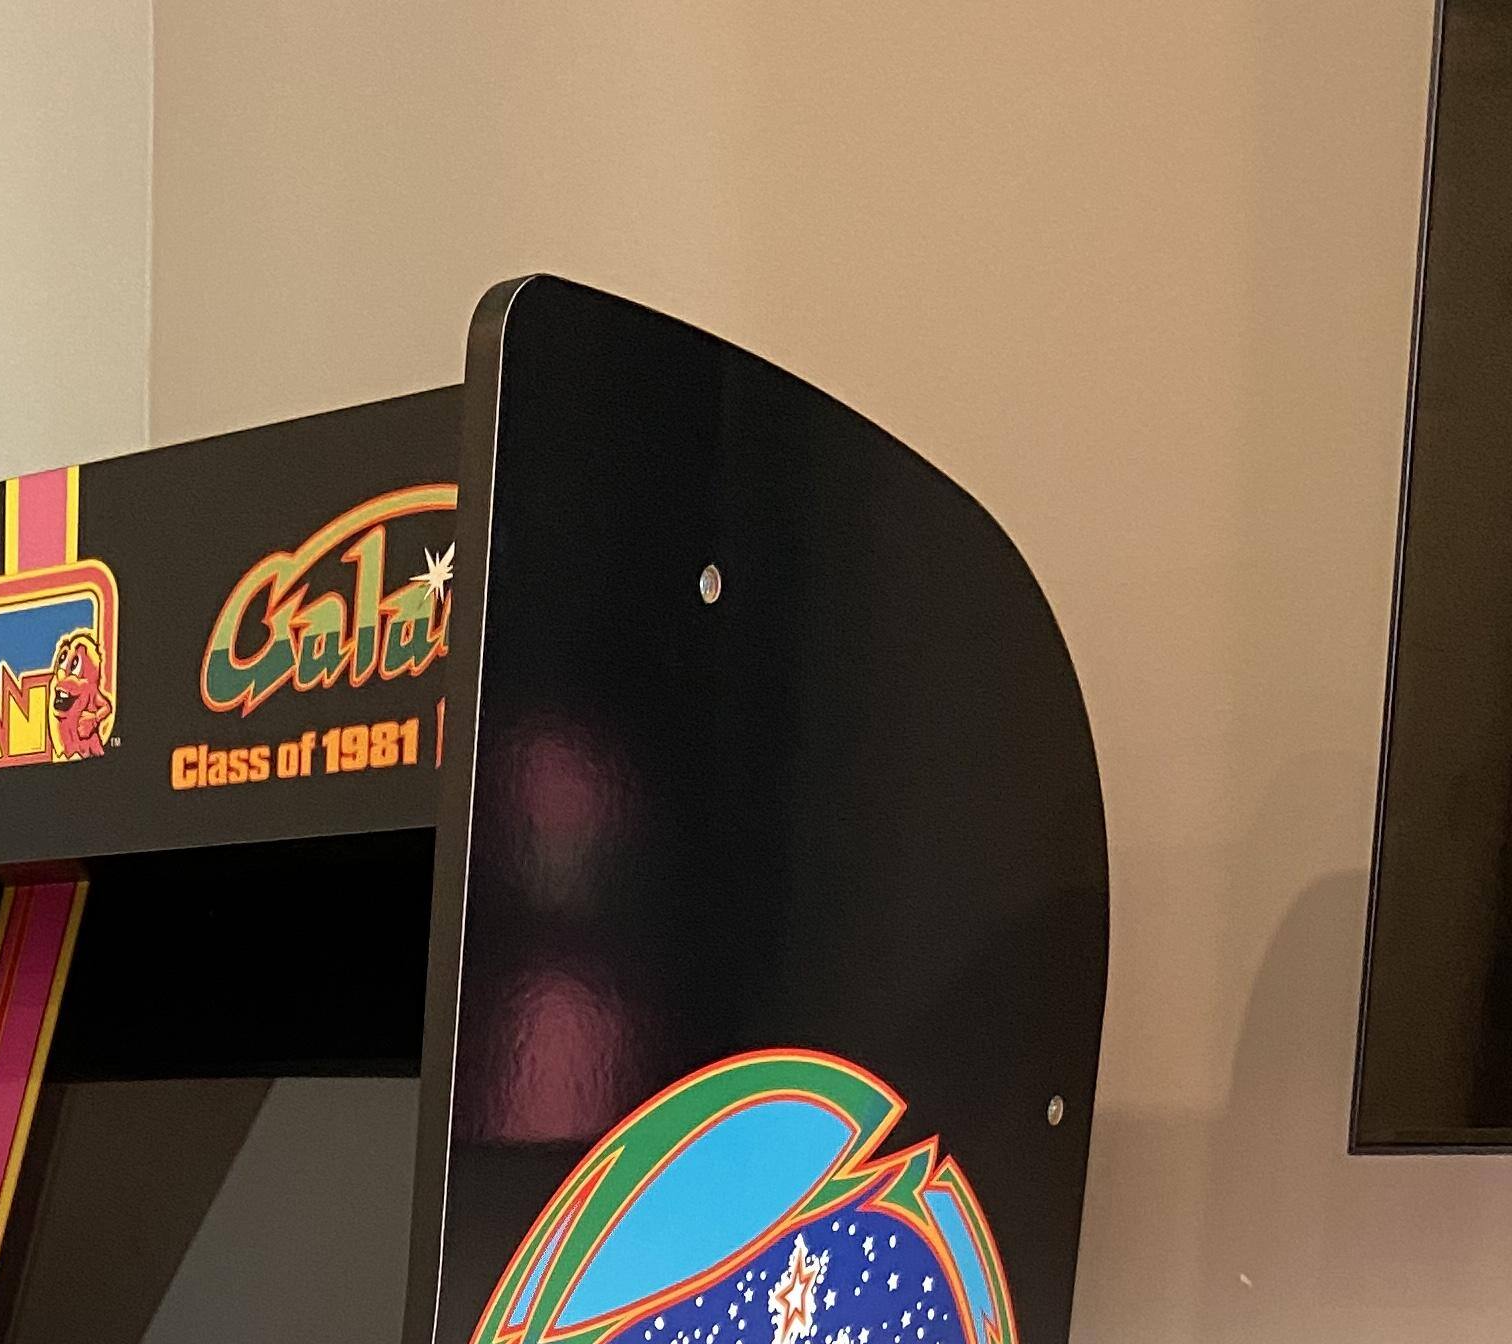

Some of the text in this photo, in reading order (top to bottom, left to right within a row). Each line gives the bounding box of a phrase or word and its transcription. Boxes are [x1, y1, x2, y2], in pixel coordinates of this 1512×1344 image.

[200, 484, 454, 717] Gala
[172, 717, 420, 790] Class of 1981
